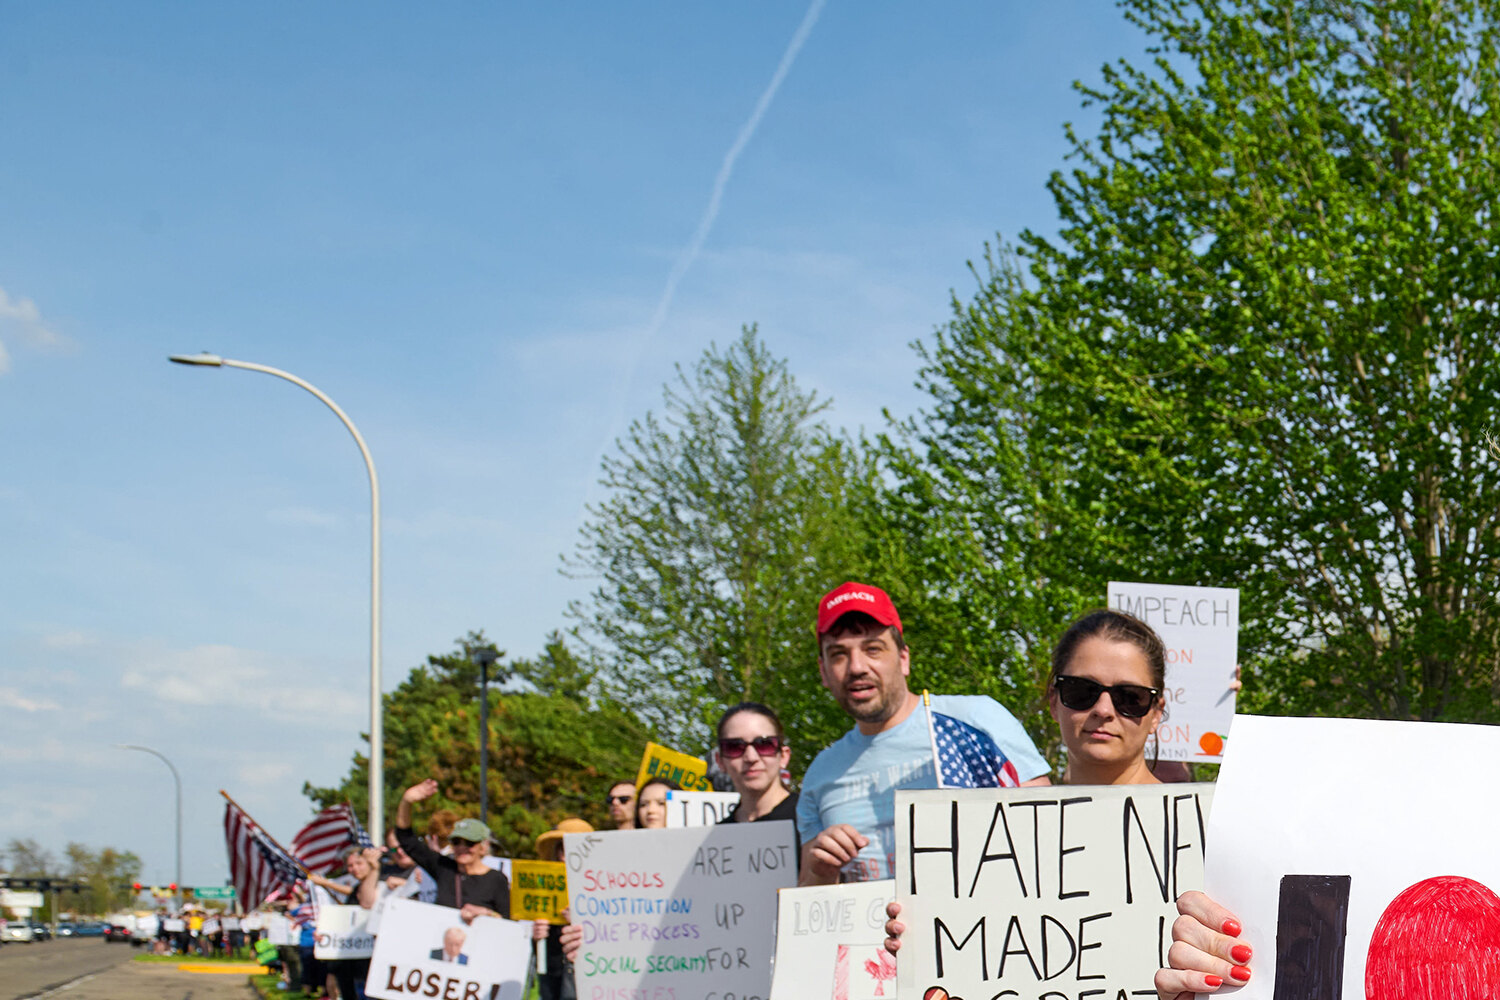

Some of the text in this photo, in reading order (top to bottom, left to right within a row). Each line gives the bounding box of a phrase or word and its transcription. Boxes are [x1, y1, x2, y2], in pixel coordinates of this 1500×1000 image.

[826, 591, 875, 609] IMPEACH
[1114, 593, 1230, 627] IMPEACH
[1166, 648, 1193, 664] ON
[1147, 723, 1190, 743] ON
[647, 757, 708, 791] HANDS
[567, 835, 603, 873] OUR
[691, 844, 790, 877] ARE NOT
[910, 796, 1093, 900] HATE
[518, 872, 566, 891] HANDS
[583, 869, 665, 892] SCHOOLS
[524, 893, 558, 918] OFF!
[574, 893, 693, 917] CONSTITUTION
[715, 902, 745, 930] UP
[793, 896, 856, 935] LOVE
[581, 920, 700, 945] DUE PROCESS
[935, 911, 1112, 981] MADE
[583, 951, 707, 977] SOCIAL SECURITY
[706, 947, 750, 971] FOR
